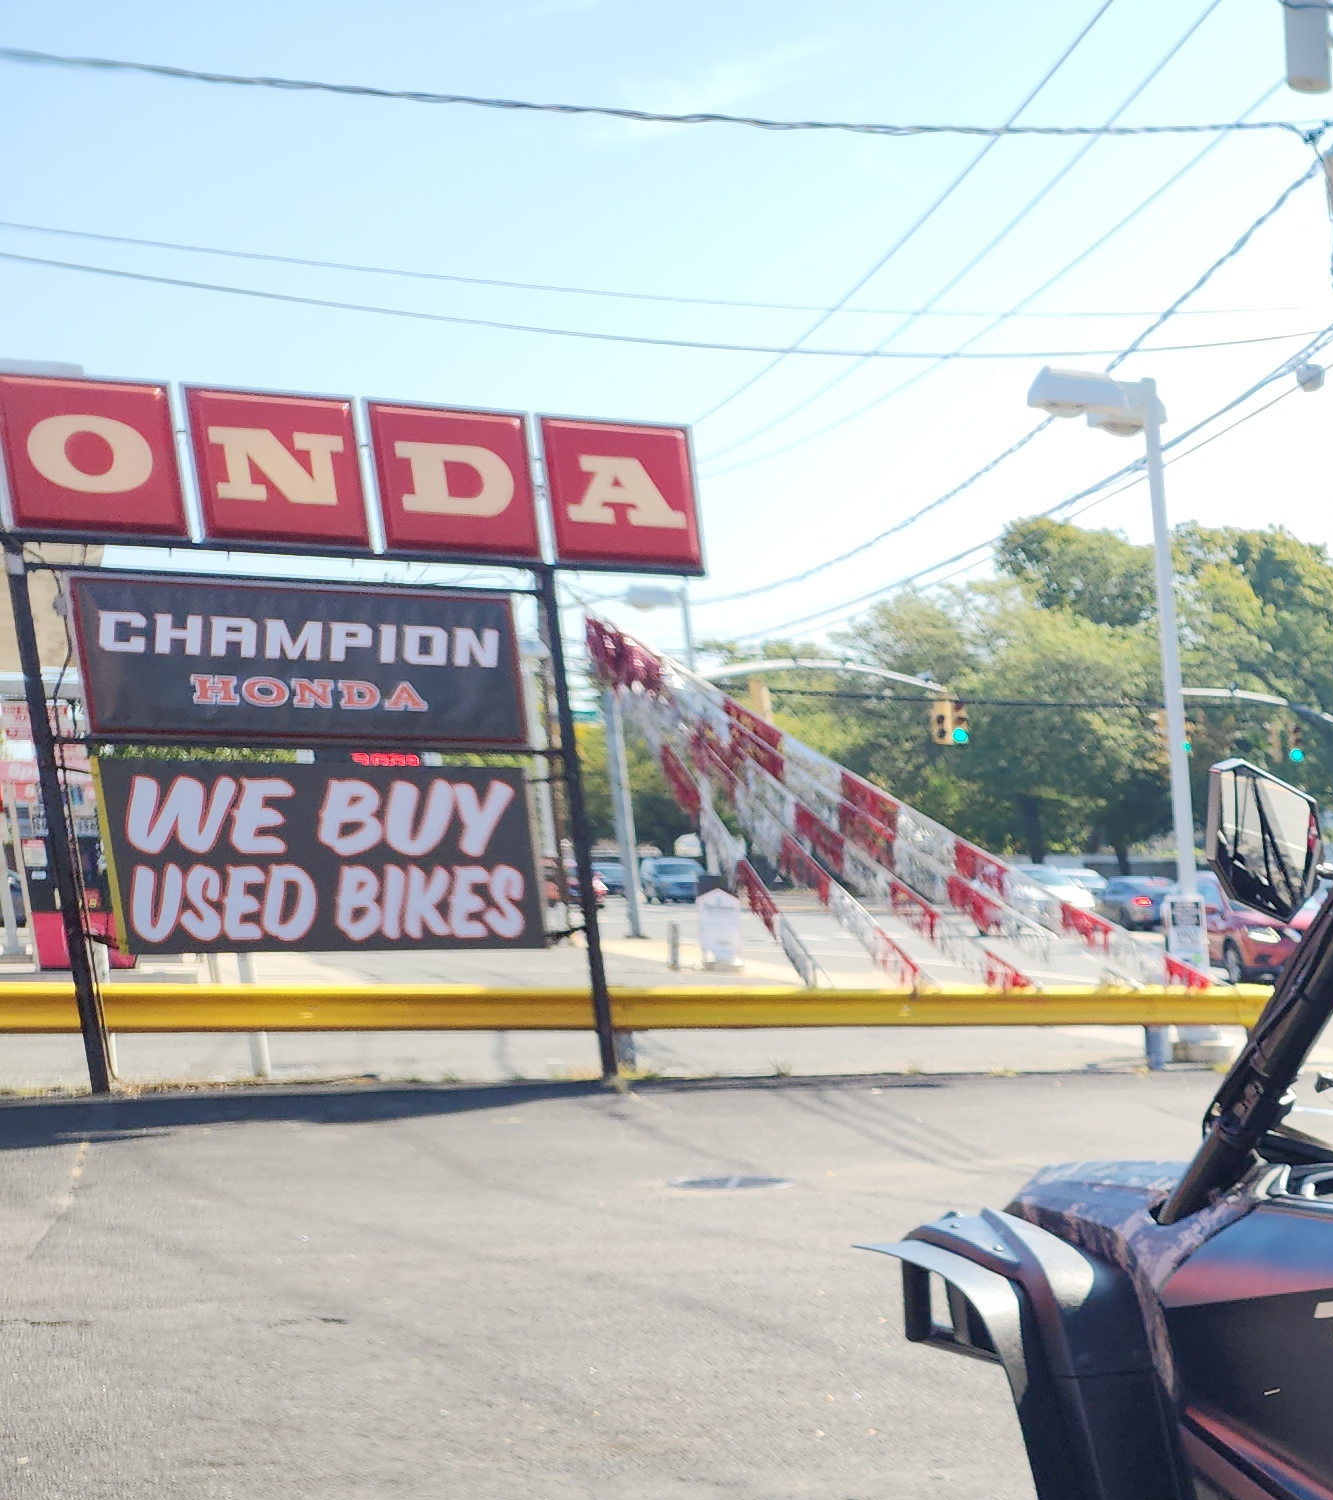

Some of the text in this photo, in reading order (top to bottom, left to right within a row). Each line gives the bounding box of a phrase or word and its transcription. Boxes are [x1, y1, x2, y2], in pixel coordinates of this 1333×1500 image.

[98, 609, 499, 669] CHAMPION
[189, 673, 430, 713] HONDA
[125, 775, 515, 858] WE BUY
[130, 864, 525, 943] USED BIKES
